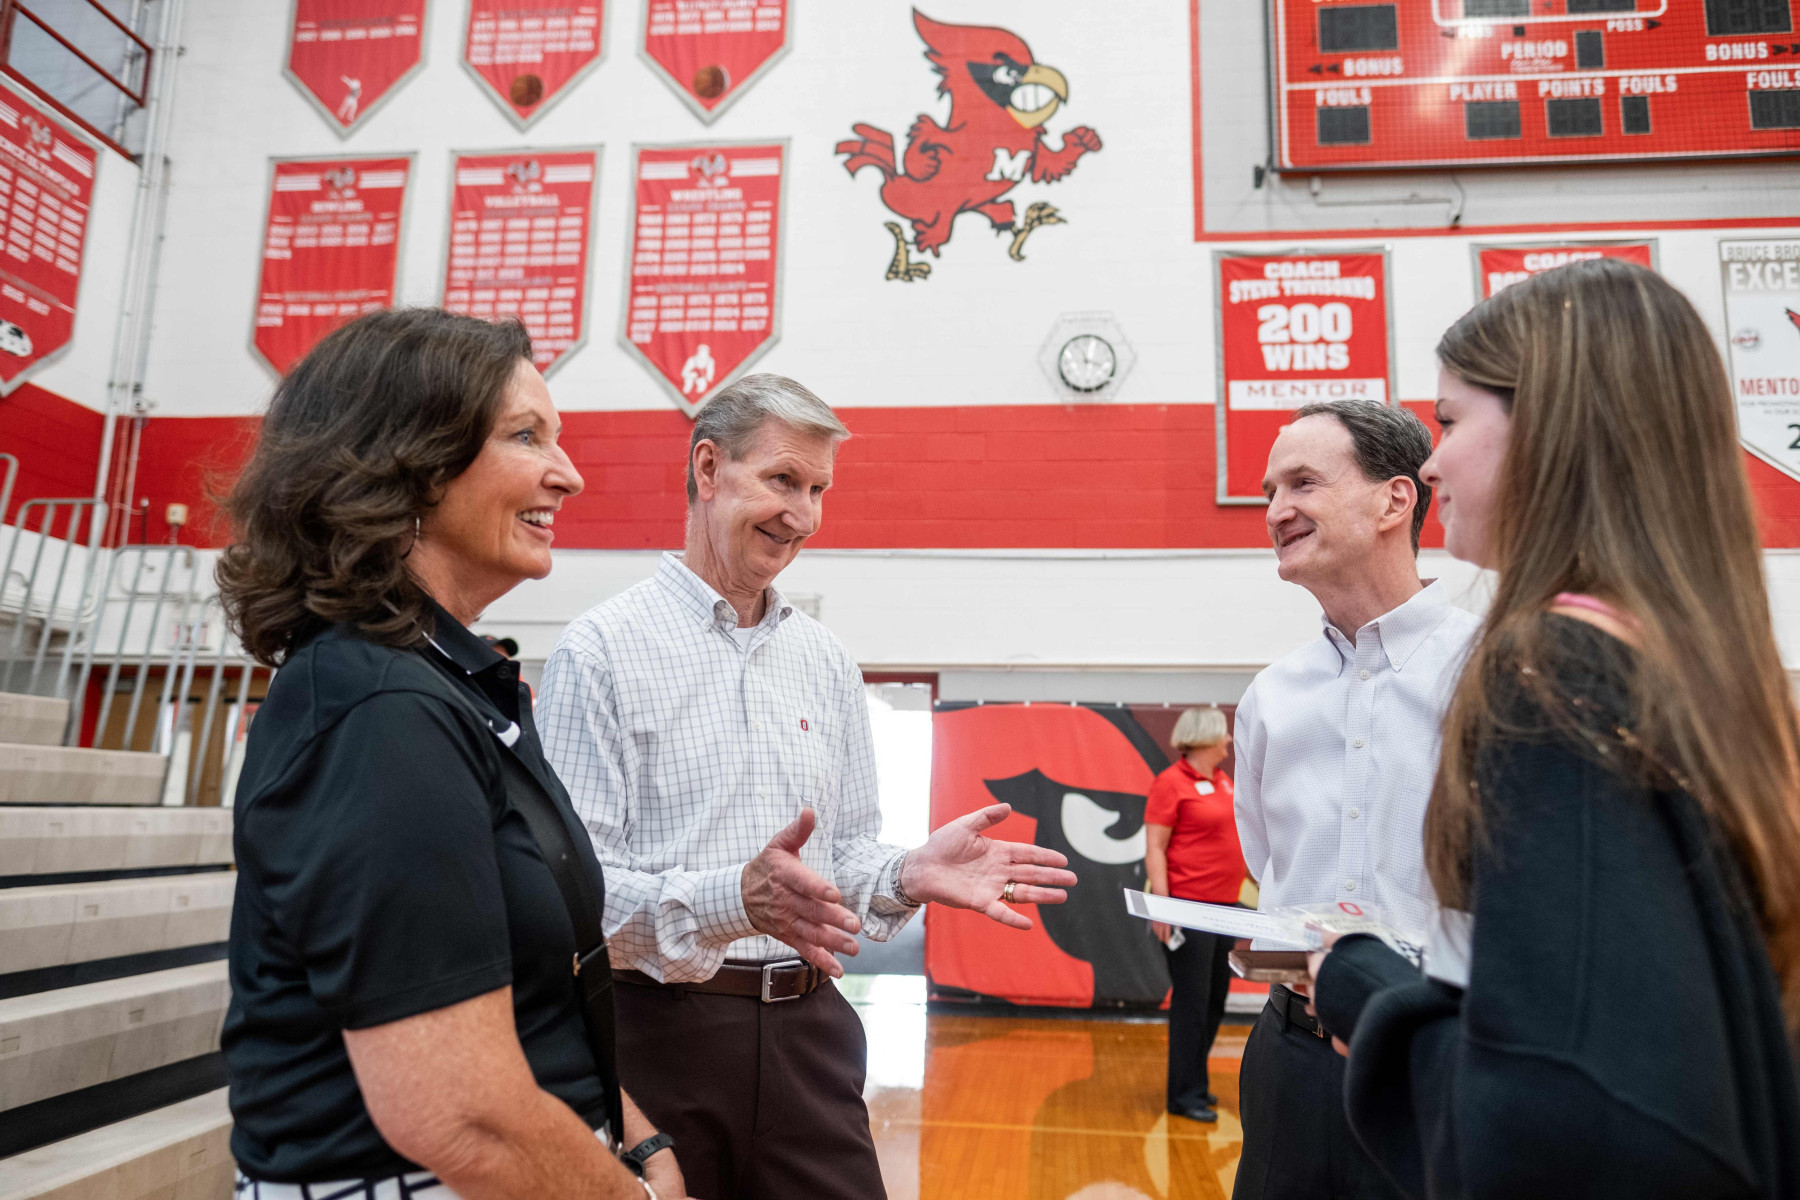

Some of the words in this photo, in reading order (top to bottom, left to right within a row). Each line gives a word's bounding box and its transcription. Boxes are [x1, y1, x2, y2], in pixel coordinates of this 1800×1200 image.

[1607, 20, 1643, 32] POSS
[1501, 41, 1568, 60] PERIOD
[1705, 42, 1769, 61] BONUS
[1343, 57, 1404, 77] BONUS
[1538, 78, 1605, 97] POINTS
[1619, 75, 1678, 94] FOULS
[1746, 71, 1800, 89] FOULS
[1315, 87, 1372, 107] FOULS
[1450, 82, 1517, 101] PLAYER
[985, 147, 1032, 182] M
[1727, 246, 1769, 261] BRUCE
[1264, 261, 1341, 279] COACH
[1257, 303, 1353, 344] 200
[1261, 343, 1350, 371] WINS
[1247, 383, 1368, 398] MENTOR
